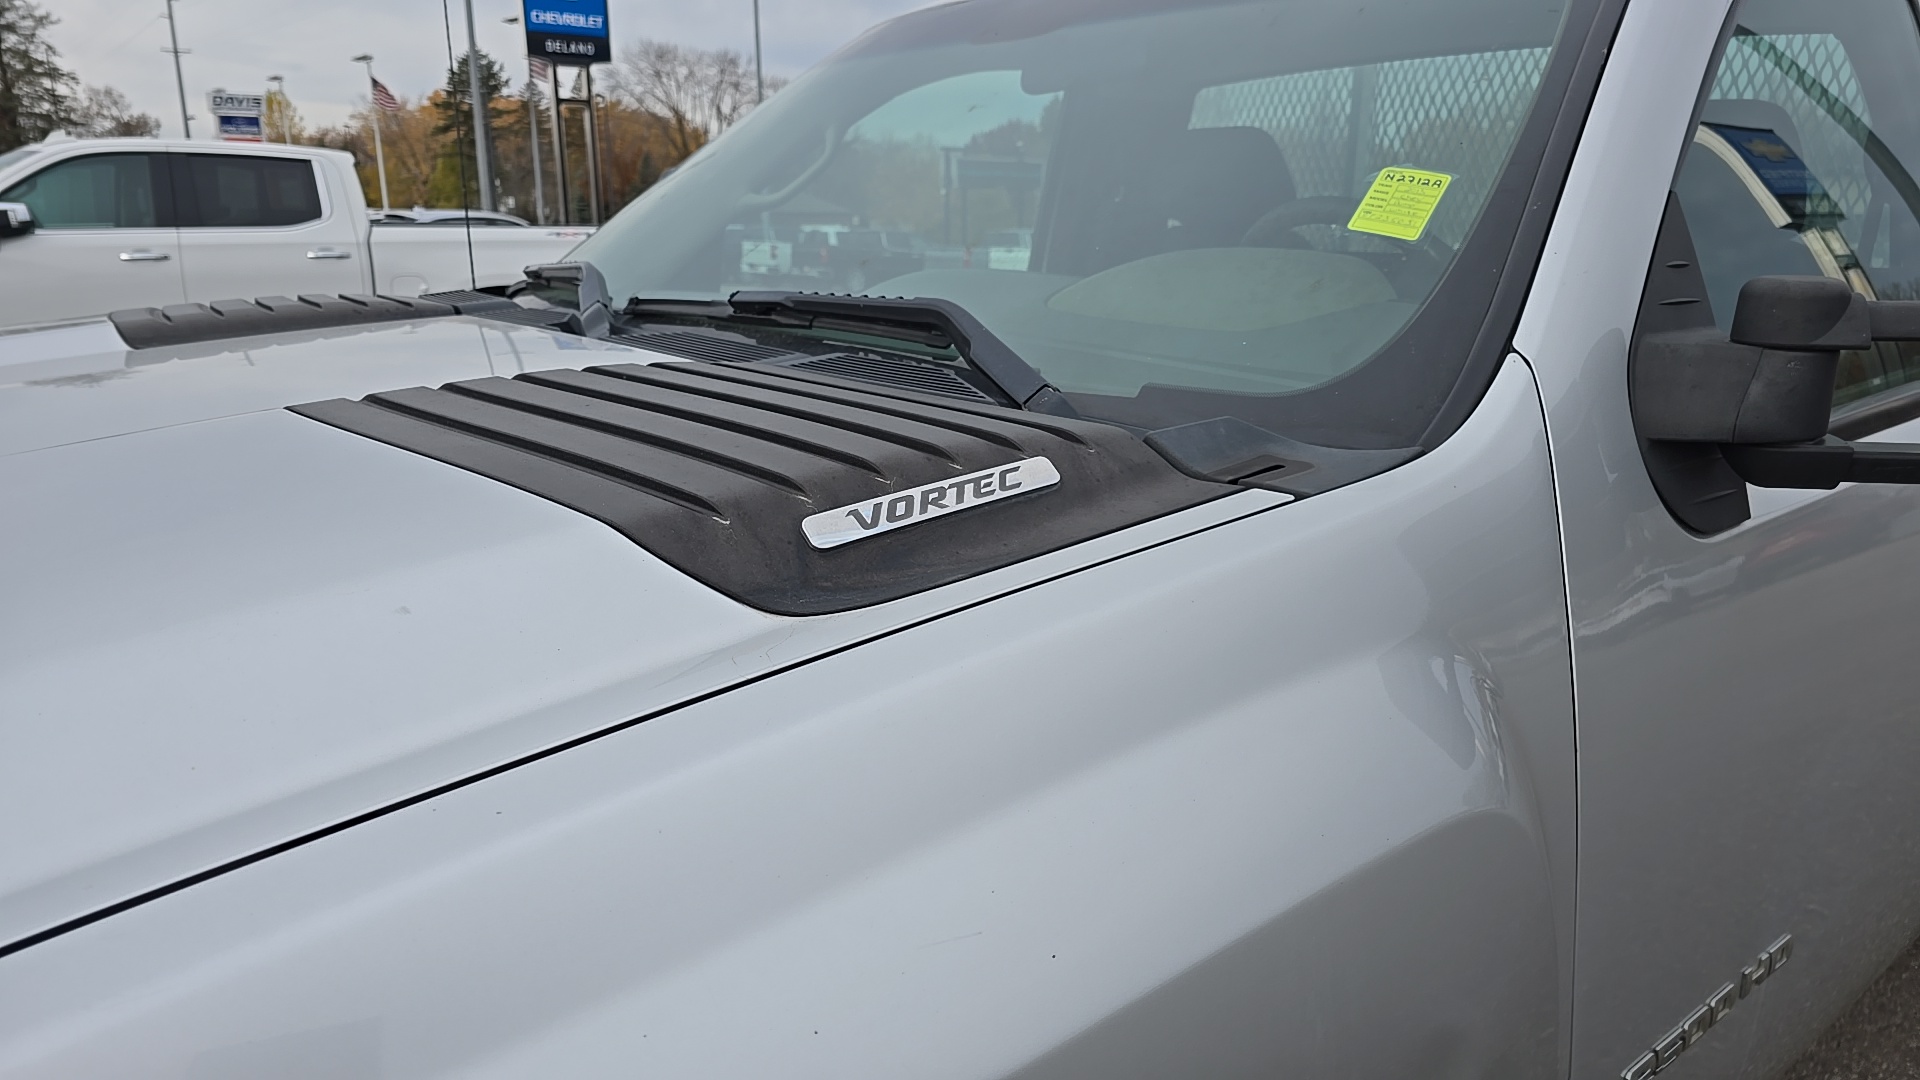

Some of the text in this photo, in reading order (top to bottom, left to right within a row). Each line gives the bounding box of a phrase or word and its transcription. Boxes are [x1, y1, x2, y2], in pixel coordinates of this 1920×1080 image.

[530, 9, 603, 28] CHEVROLET
[212, 95, 262, 108] DAVIS
[844, 466, 1022, 530] VORTEC
[1738, 932, 1793, 1000] HD
